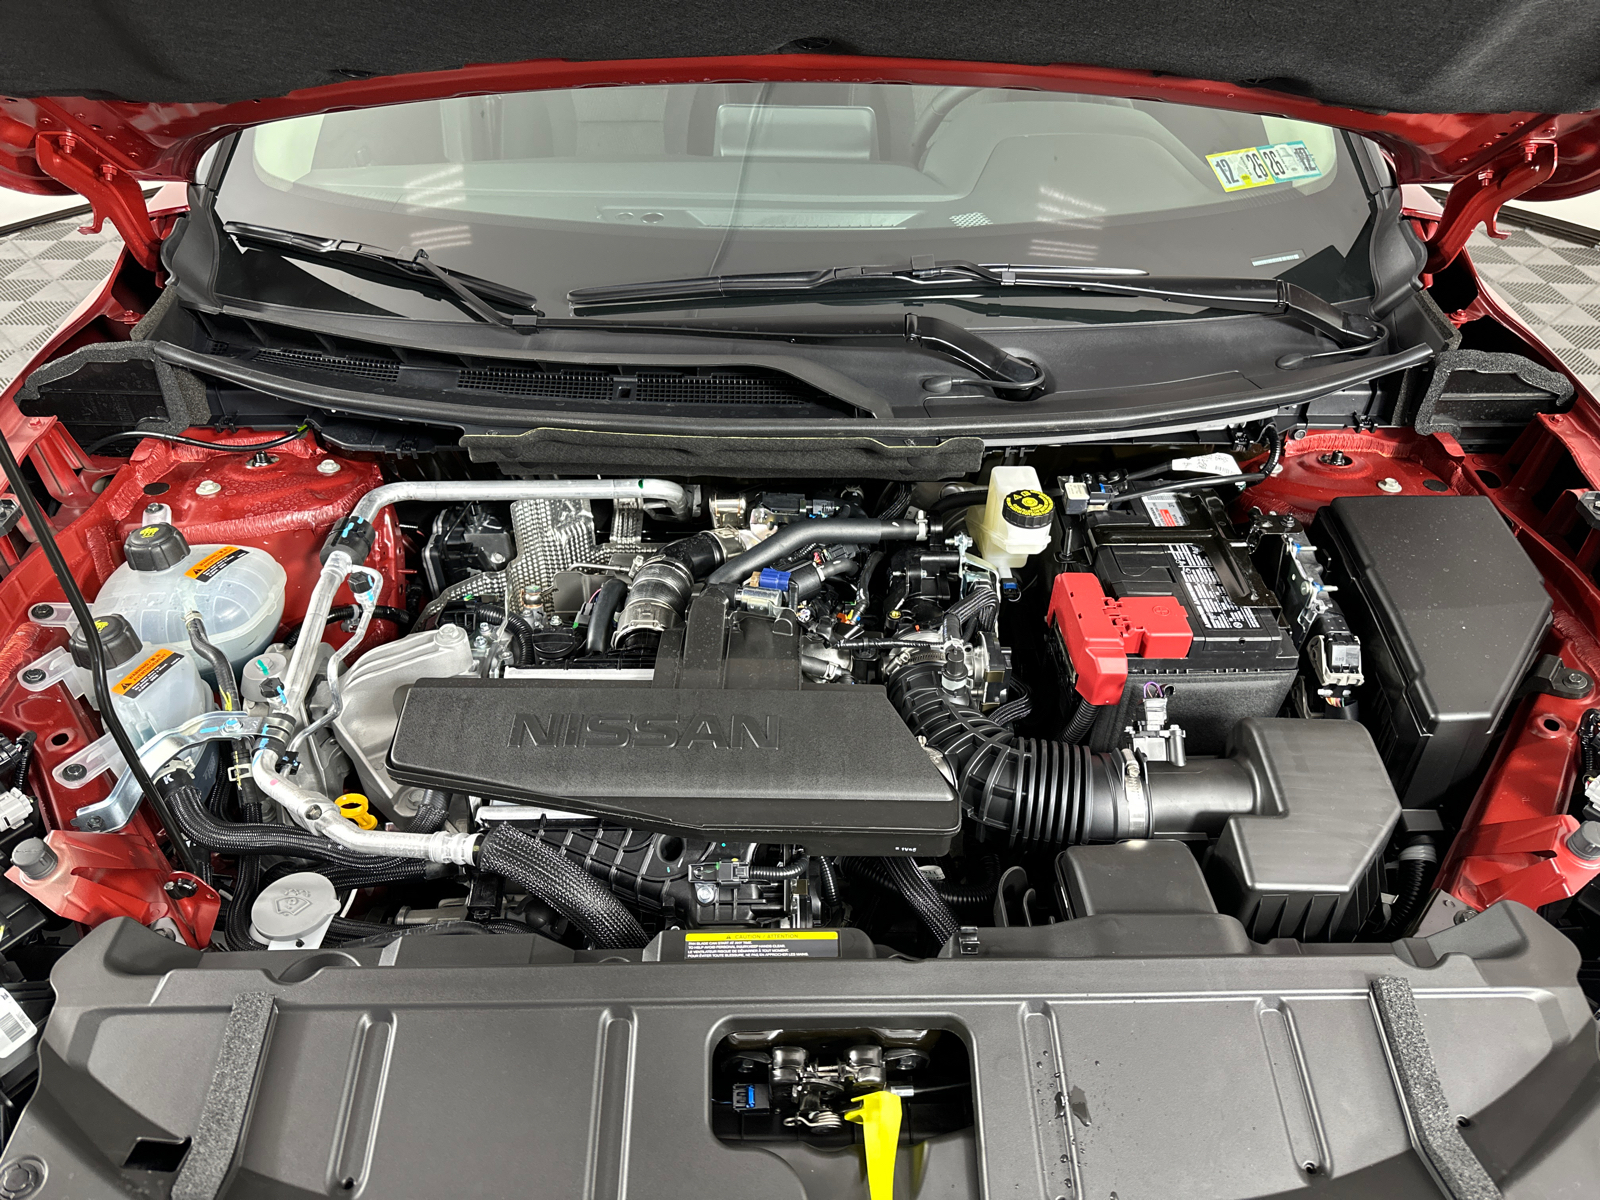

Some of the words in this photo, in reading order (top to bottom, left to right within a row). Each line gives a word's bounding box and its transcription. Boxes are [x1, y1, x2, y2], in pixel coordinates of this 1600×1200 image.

[1215, 158, 1240, 184] 12
[1246, 153, 1268, 178] 26
[1263, 150, 1286, 176] 26
[506, 714, 780, 750] NISSAN
